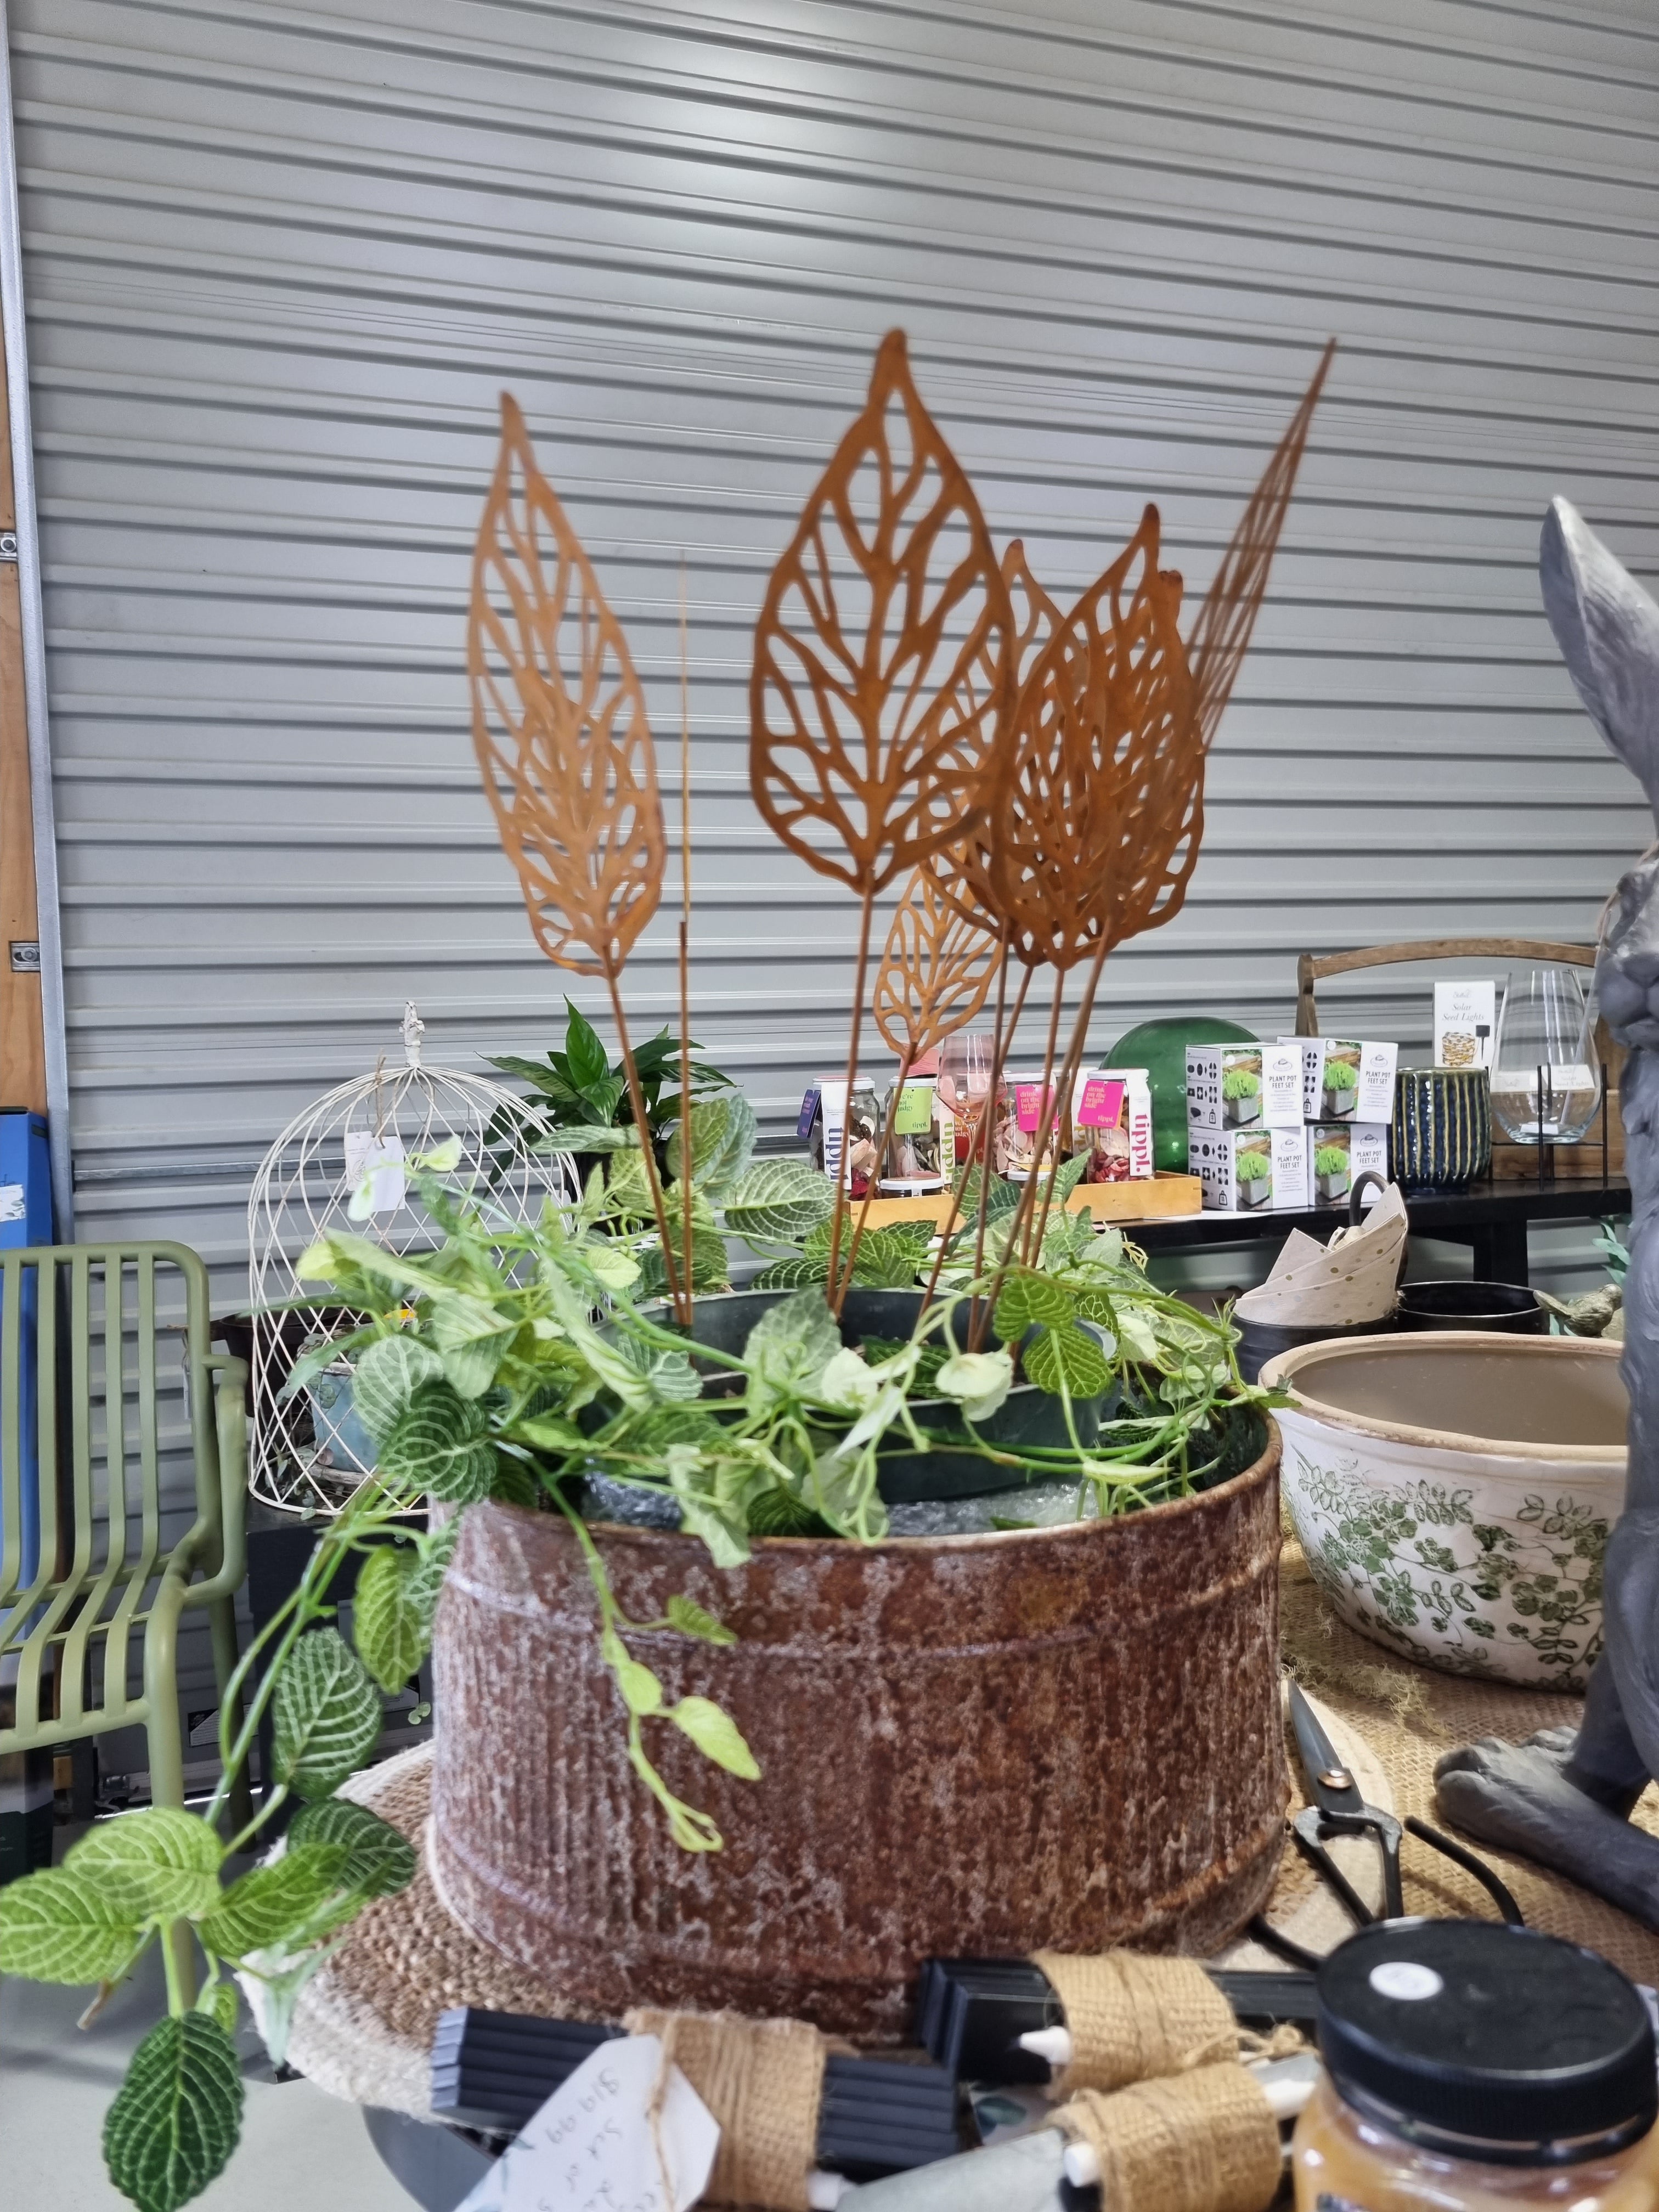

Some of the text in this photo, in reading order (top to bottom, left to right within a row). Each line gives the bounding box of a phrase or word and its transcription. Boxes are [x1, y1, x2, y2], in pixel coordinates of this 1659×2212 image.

[1442, 1013, 1484, 1022] Seed Lights
[1131, 1114, 1150, 1172] tippl.
